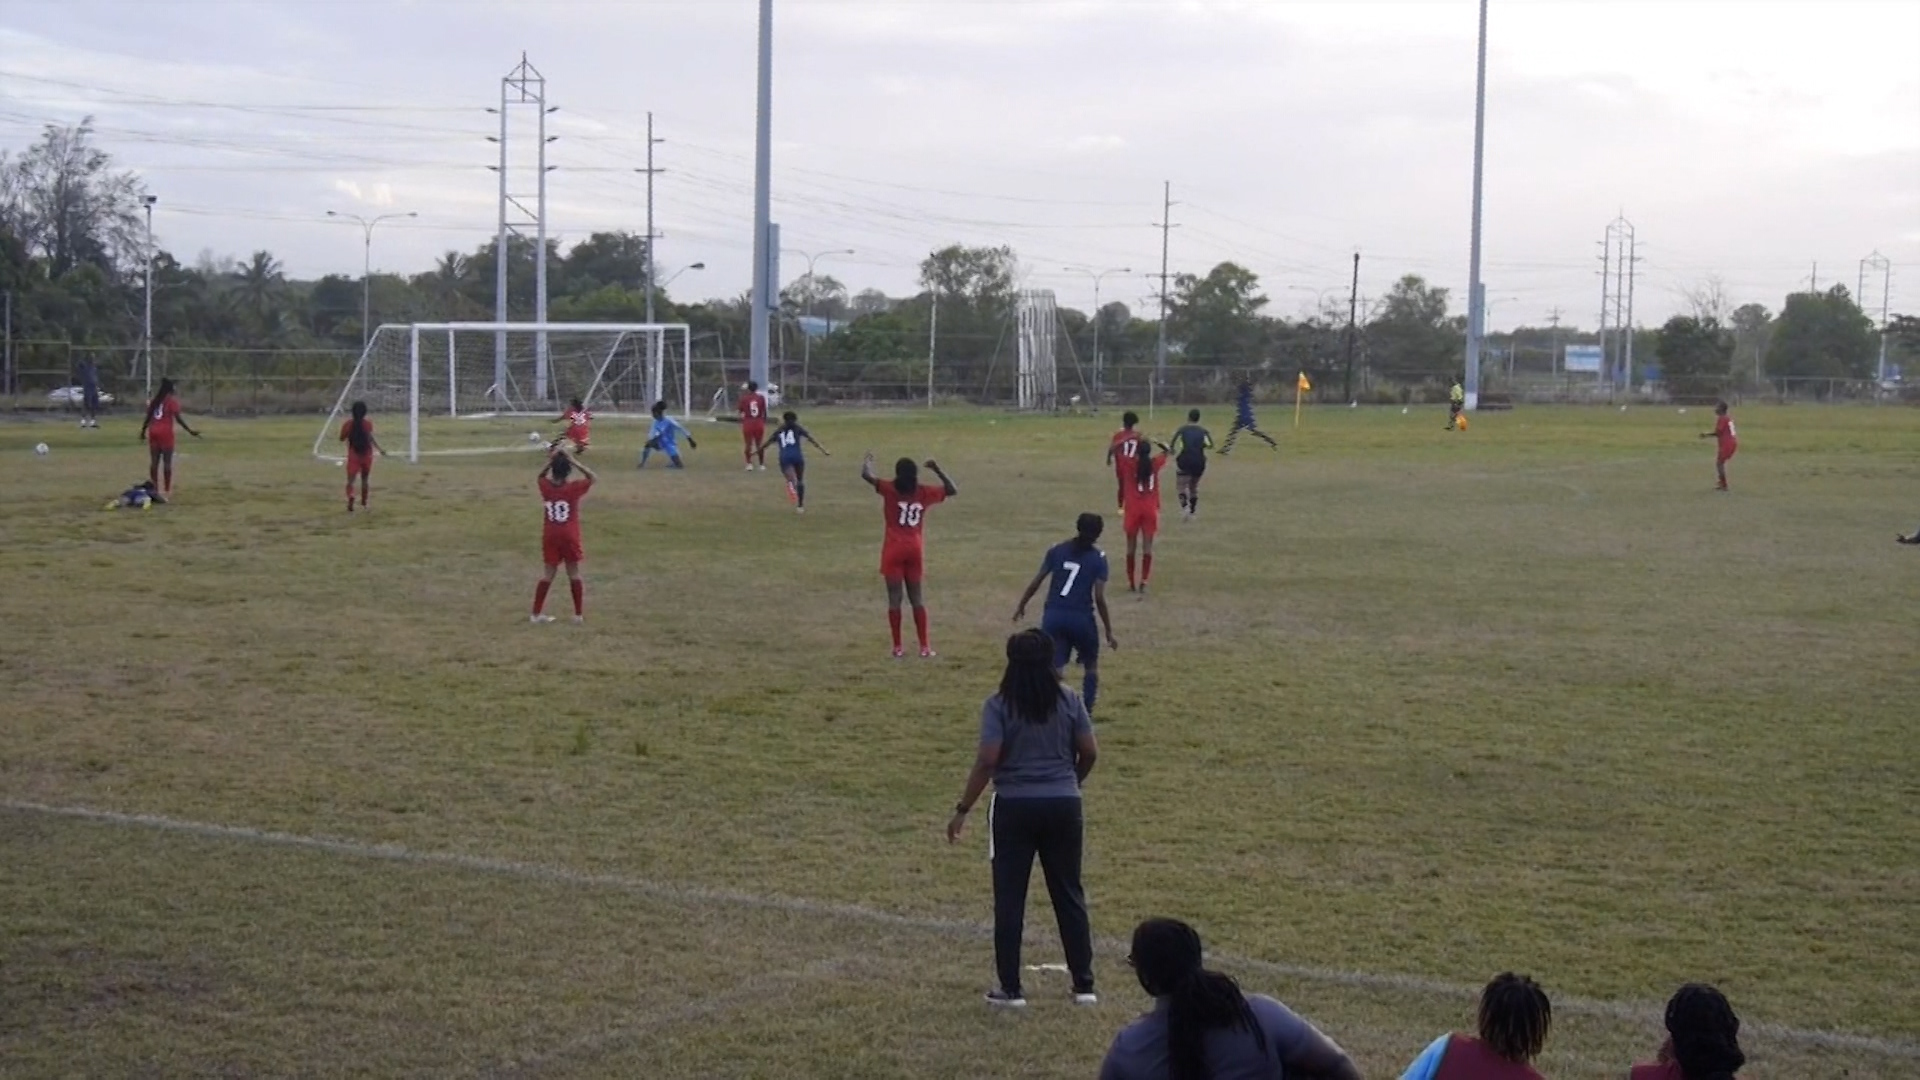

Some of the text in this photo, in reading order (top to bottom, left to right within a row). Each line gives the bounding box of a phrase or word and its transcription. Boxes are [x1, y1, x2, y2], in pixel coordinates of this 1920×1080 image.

[779, 430, 796, 448] 14
[1124, 440, 1138, 458] 17
[1060, 561, 1081, 596] 7
